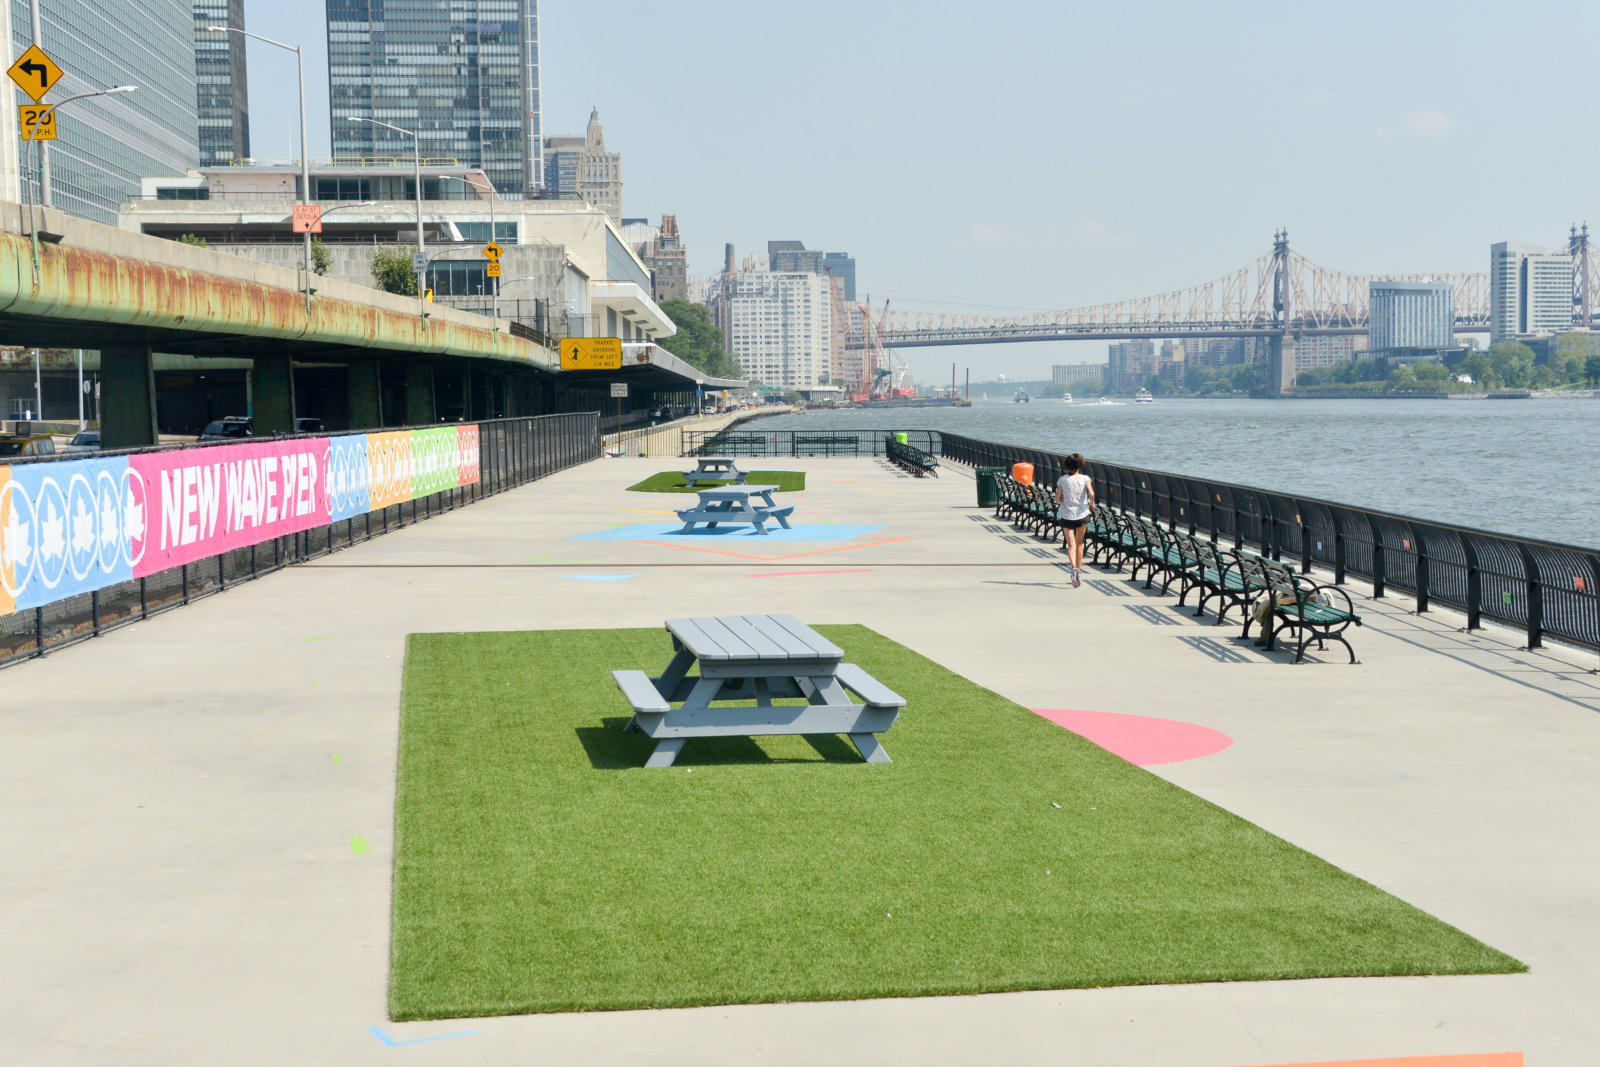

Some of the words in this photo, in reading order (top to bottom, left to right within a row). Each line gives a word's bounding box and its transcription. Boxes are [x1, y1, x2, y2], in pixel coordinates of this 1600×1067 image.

[25, 110, 52, 126] 20
[488, 264, 500, 272] 20
[160, 463, 221, 551] NEW
[224, 456, 278, 534] WAVE
[280, 452, 318, 521] PIER
